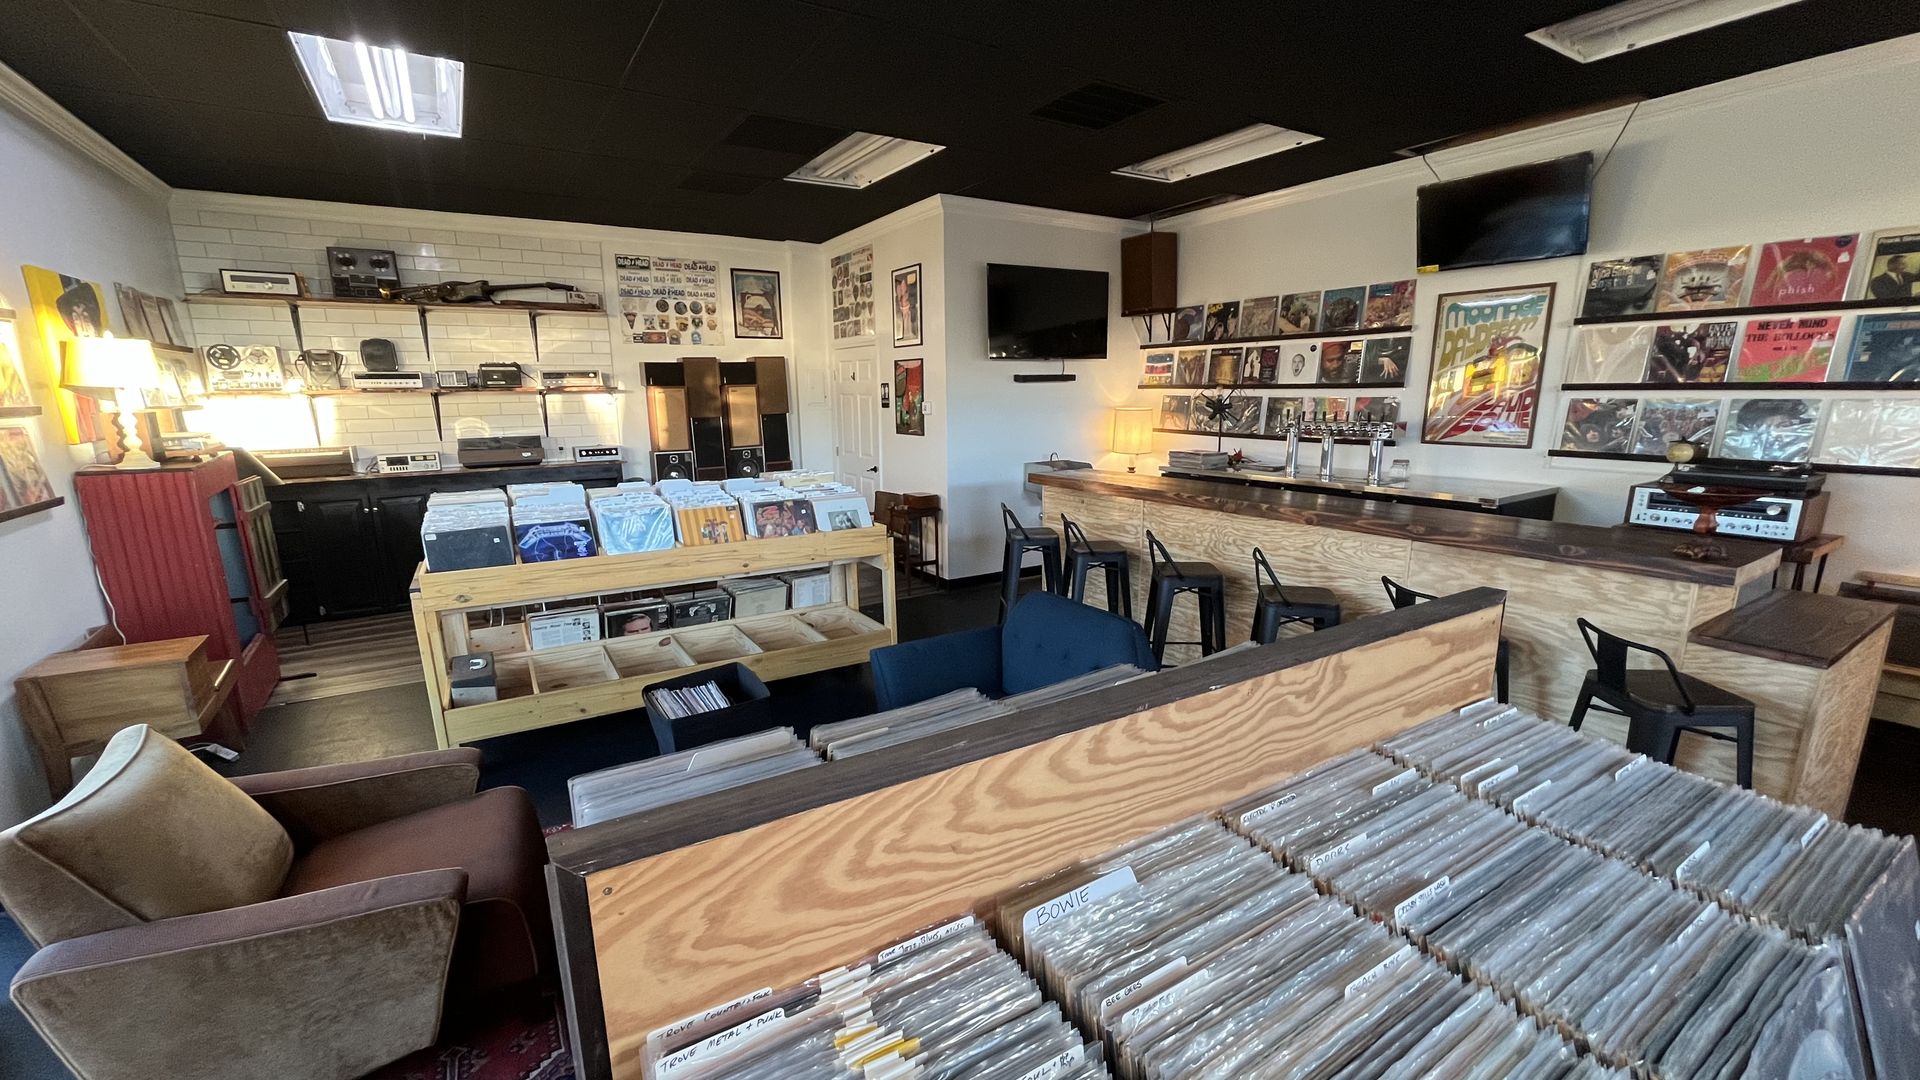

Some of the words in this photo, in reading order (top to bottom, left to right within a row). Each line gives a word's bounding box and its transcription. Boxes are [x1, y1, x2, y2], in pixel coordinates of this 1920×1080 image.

[1778, 284, 1815, 298] phish
[1445, 294, 1549, 329] MOONAGE
[1757, 320, 1795, 331] NEVER
[1797, 318, 1829, 329] MIND
[1745, 333, 1769, 343] THE
[1036, 885, 1090, 926] BOWIE
[1105, 993, 1121, 1007] BEE
[656, 1019, 695, 1040] TROVE
[660, 1046, 697, 1072] TROVE
[706, 1028, 741, 1050] METAL
[756, 1010, 783, 1028] PUNK
